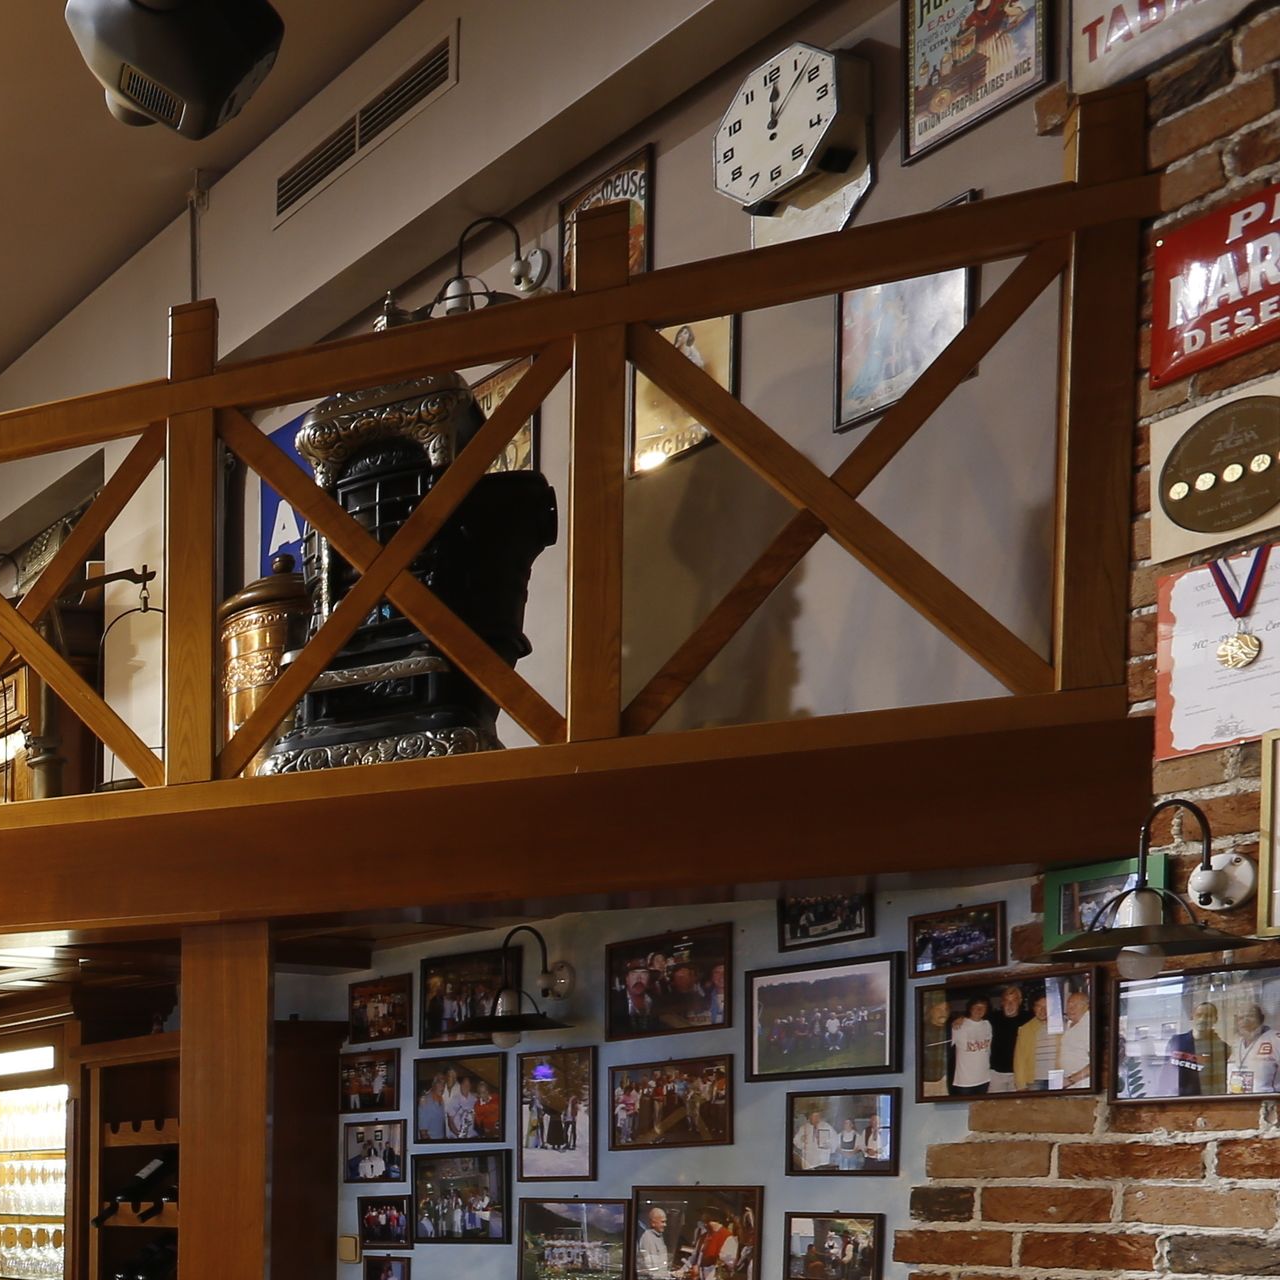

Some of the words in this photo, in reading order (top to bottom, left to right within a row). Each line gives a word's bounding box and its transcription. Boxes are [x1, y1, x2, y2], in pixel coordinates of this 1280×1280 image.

[763, 65, 781, 88] 12
[808, 65, 820, 83] 2
[745, 90, 754, 105] 11
[816, 83, 828, 101] 3
[918, 113, 940, 136] UNION
[1014, 57, 1032, 79] NICE
[728, 119, 742, 137] 10
[809, 113, 822, 128] 4
[723, 147, 734, 164] 9
[792, 144, 804, 161] 5
[731, 165, 743, 182] 8
[749, 172, 760, 189] 7
